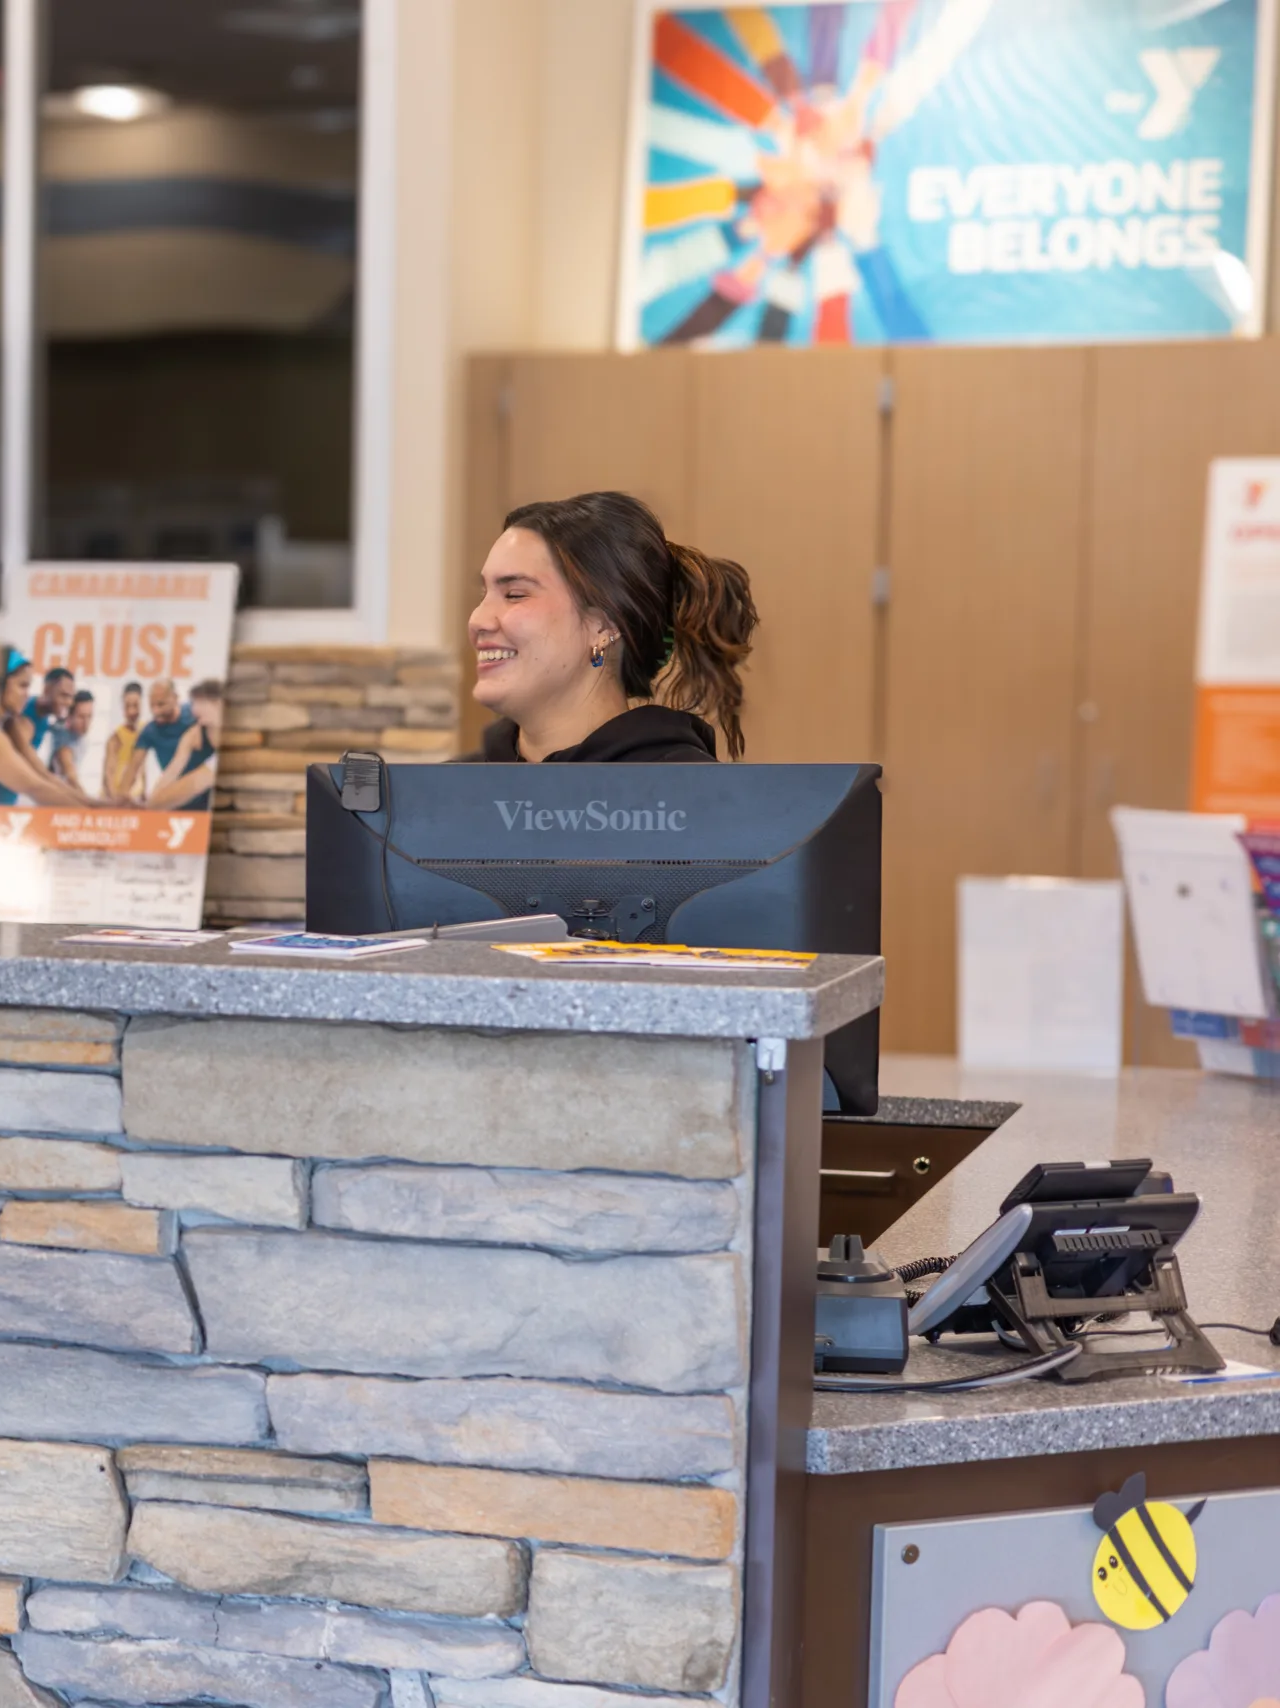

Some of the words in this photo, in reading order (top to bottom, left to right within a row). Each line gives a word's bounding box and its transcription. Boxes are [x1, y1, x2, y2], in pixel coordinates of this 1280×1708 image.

[908, 158, 1223, 222] EVERYONE
[948, 215, 1220, 274] BELONGS
[33, 622, 197, 678] CAUSE
[493, 799, 689, 832] ViewSonic
